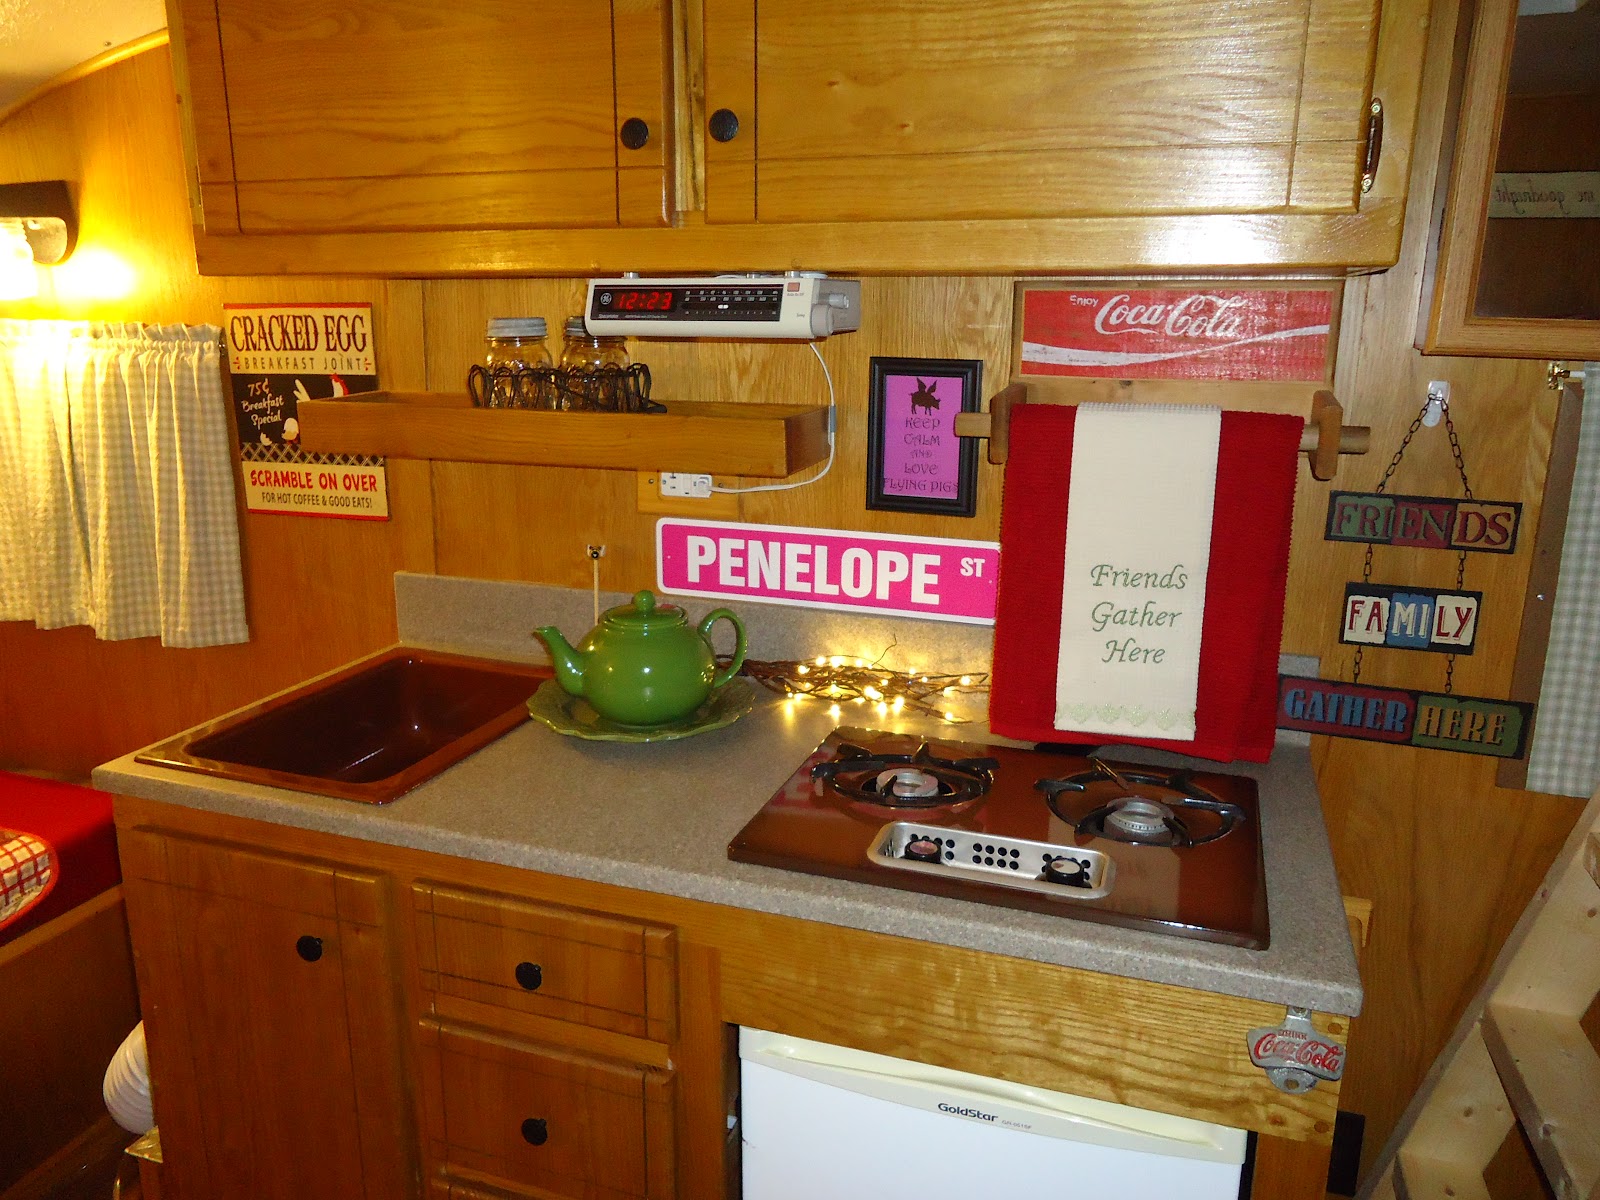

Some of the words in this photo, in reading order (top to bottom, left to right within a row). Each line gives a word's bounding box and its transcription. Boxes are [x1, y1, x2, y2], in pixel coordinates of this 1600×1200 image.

[618, 291, 673, 311] 12:23
[1069, 294, 1098, 307] Enjoy
[230, 315, 319, 352] CRACKED
[324, 315, 367, 352] EGG
[245, 356, 315, 370] BREAKFAST
[324, 357, 362, 371] JOINT
[241, 393, 284, 414] Breakfast
[250, 410, 282, 430] Special
[904, 433, 940, 446] CALM
[911, 450, 933, 459] AND
[250, 469, 313, 489] SCRAMBLE
[319, 472, 338, 491] ON
[343, 474, 377, 492] OVER
[262, 492, 276, 503] FOR
[277, 493, 291, 504] HOT
[292, 494, 320, 506] COFFEE
[321, 496, 327, 506] &
[329, 496, 351, 507] GOOD
[352, 497, 373, 509] EATS!
[1333, 502, 1512, 546] FRIENDS
[687, 535, 941, 605] PENELOPE
[960, 557, 985, 578] ST
[1090, 564, 1188, 590] Friends
[1091, 600, 1182, 632] Gather
[1347, 600, 1474, 640] FAMILY
[1101, 637, 1166, 664] Here
[1283, 688, 1408, 734] GATHER
[1418, 704, 1506, 746] HERE
[937, 1102, 998, 1122] GoldStar
